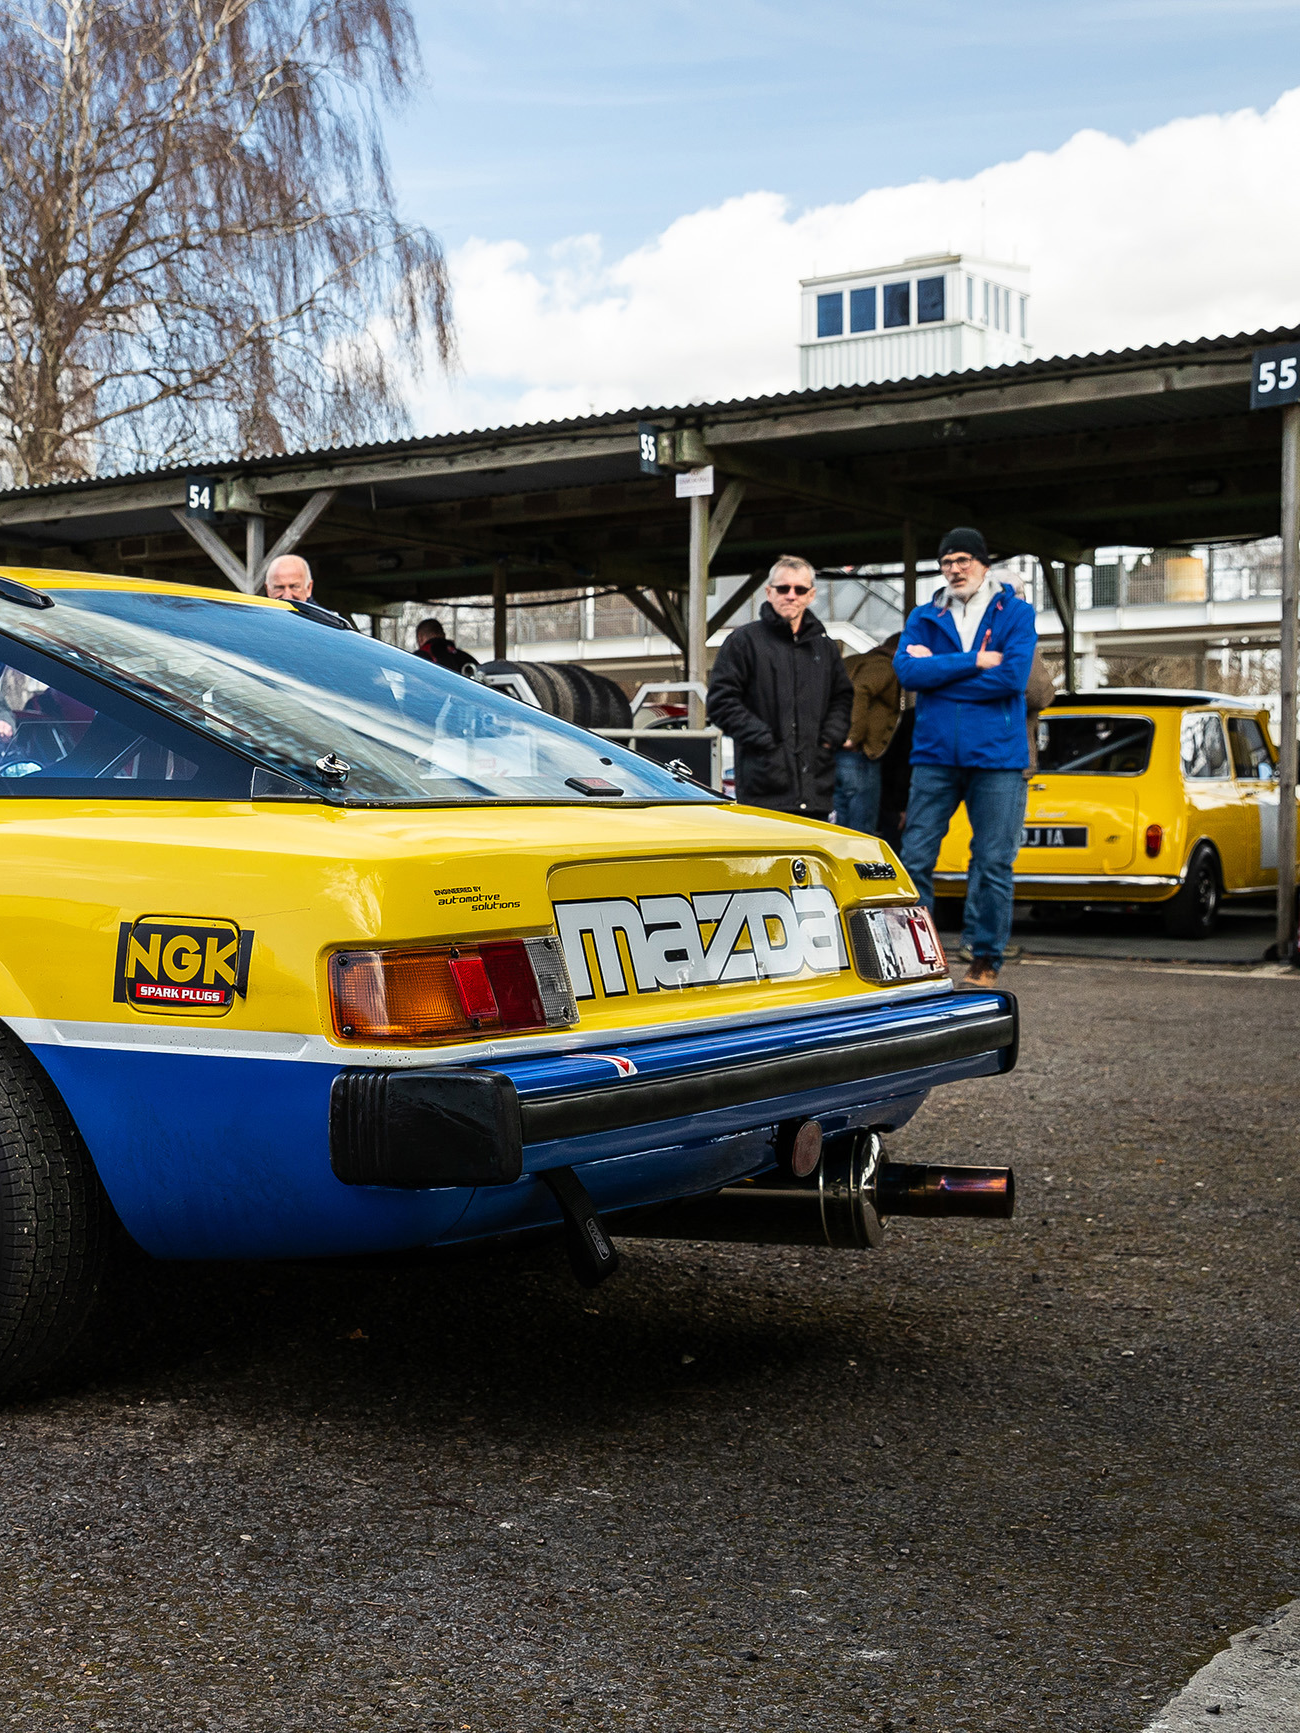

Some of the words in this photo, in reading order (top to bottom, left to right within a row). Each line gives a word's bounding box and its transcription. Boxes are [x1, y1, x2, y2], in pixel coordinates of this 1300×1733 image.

[1257, 357, 1298, 393] 55
[640, 433, 656, 462] 55
[188, 484, 211, 510] 54
[433, 886, 473, 896] ENGINEERED
[473, 885, 482, 893] BY
[438, 893, 501, 906] automotive
[471, 901, 521, 912] solutions
[125, 933, 239, 986] NGK
[140, 985, 180, 999] SPARK
[181, 988, 221, 1002] PLUGS
